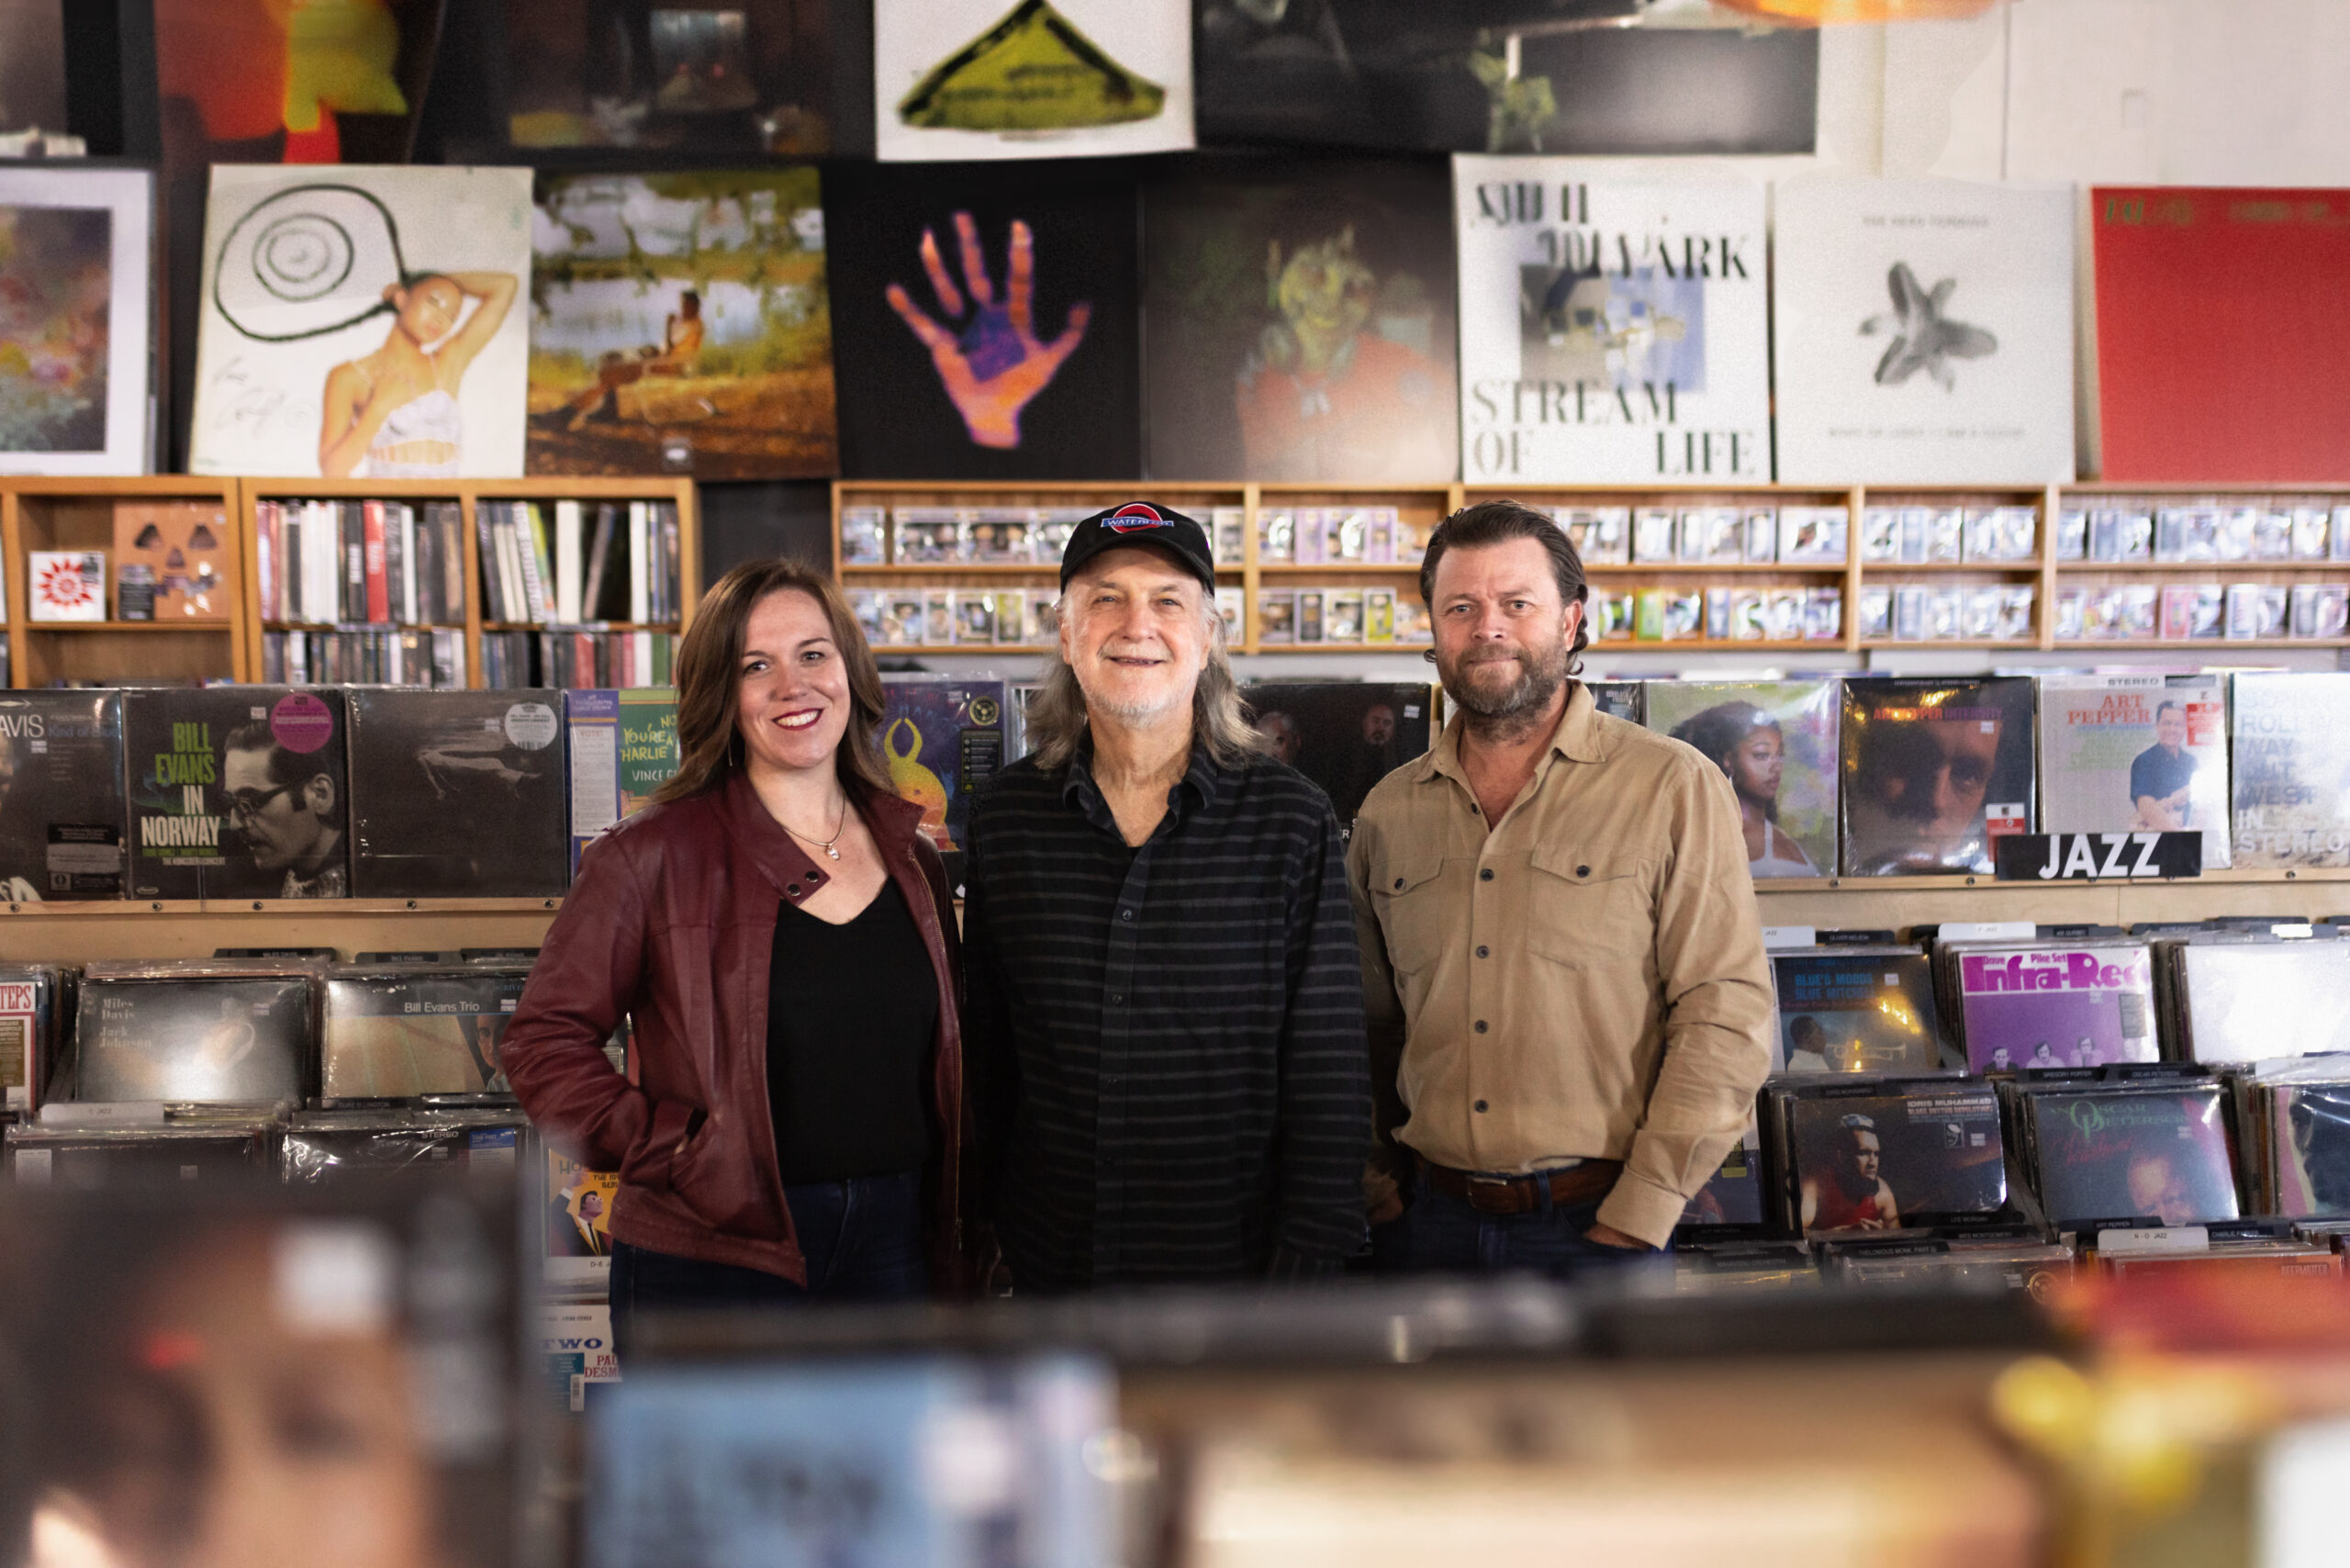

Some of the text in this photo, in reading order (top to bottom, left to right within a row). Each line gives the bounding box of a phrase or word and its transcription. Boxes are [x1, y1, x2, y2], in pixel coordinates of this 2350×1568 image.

[1472, 380, 1677, 425] STREAM
[1472, 431, 1754, 474] OF LIFE
[2108, 678, 2159, 686] STEREO
[2101, 694, 2145, 709] ART
[0, 714, 45, 738] AVIS
[660, 714, 677, 728] NO
[2067, 709, 2152, 725] PEPPER
[173, 722, 213, 753] BILL
[620, 745, 668, 763] HARLIE
[155, 754, 217, 784] EVANS
[184, 785, 205, 815] IN
[2238, 809, 2265, 830] IN
[140, 816, 220, 846] NORWAY
[2238, 831, 2345, 854] STEREO
[2038, 832, 2163, 880] JAZZ
[1983, 953, 2066, 965] Dave Pike Set
[0, 985, 31, 1010] TEPS
[404, 1001, 480, 1014] Bill Evans Trio
[101, 1009, 136, 1020] Davis
[1907, 1097, 1992, 1108] IDRIS MUHAMMAD
[2069, 1100, 2146, 1131] OSCAR
[421, 1130, 460, 1139] STEREO
